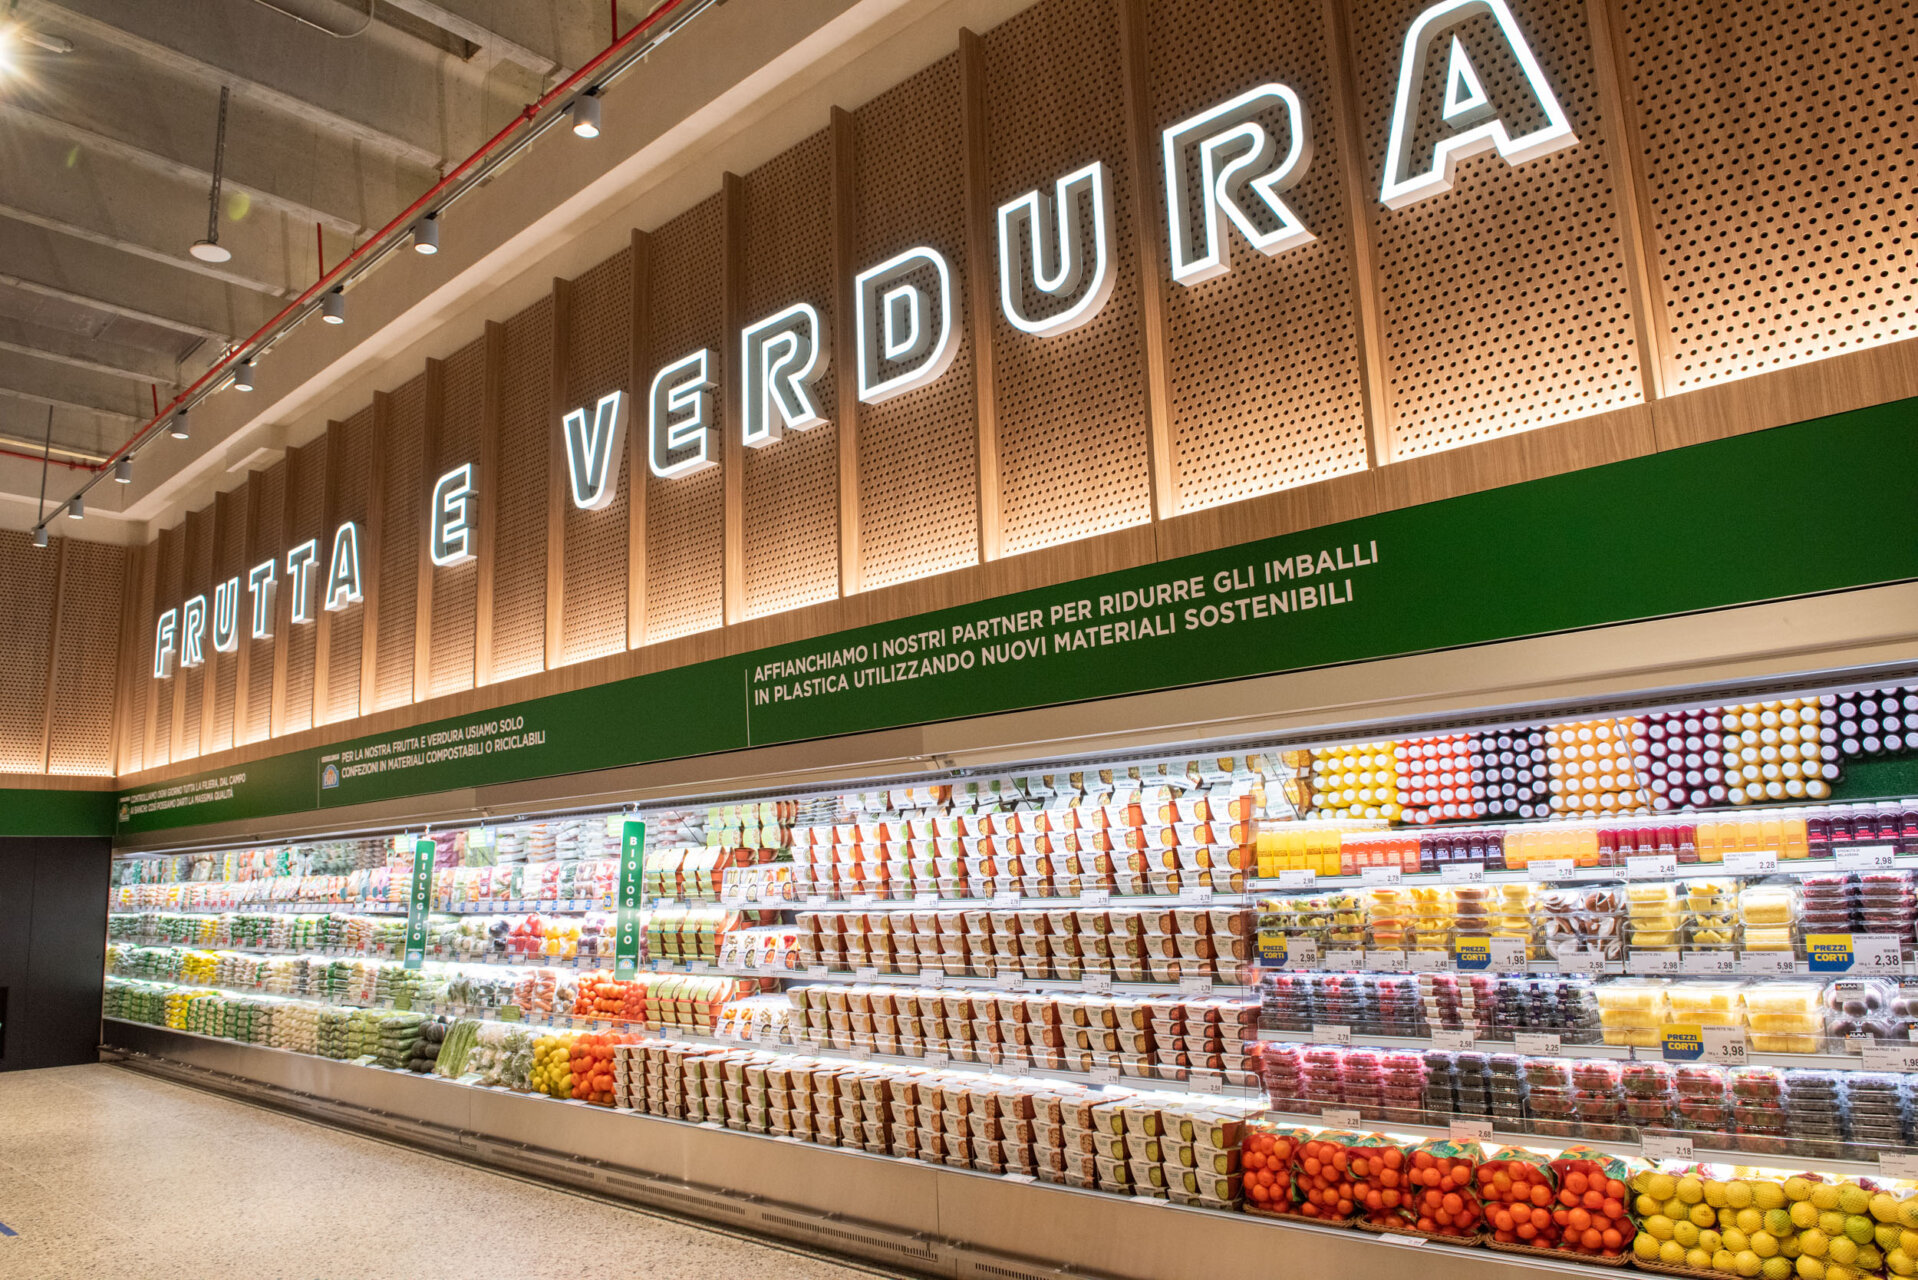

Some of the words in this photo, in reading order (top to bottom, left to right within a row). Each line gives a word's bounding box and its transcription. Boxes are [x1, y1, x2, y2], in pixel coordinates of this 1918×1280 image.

[154, 521, 363, 679] FRUTTA
[430, 462, 477, 567] E
[562, 0, 1579, 510] VERDURA
[754, 645, 868, 683] AFFIANCHIAMO
[872, 641, 879, 660] I
[882, 629, 947, 658] NOSTRI
[952, 608, 1043, 645] PARTNER
[1050, 599, 1093, 625] PER
[1099, 576, 1206, 617] RIDURRE
[1213, 565, 1255, 593] GLI
[1264, 540, 1378, 584] IMBALLI
[754, 687, 769, 706] IN
[774, 673, 849, 702] PLASTICA
[853, 649, 976, 688] UTILIZZANDO
[981, 635, 1046, 666] NUOVI
[1054, 612, 1176, 653] MATERIALI
[1184, 578, 1354, 630] SOSTENIBILI
[341, 750, 355, 763] PER
[354, 748, 364, 760] LA
[364, 743, 392, 758] NOSTRA
[392, 737, 420, 754] FRUTTA
[420, 737, 426, 748] E
[427, 728, 464, 747] VERDURA
[465, 722, 498, 739] USIAMO
[500, 716, 524, 732] SOLO
[341, 762, 379, 778] CONFEZIONI
[380, 760, 387, 771] IN
[388, 752, 425, 769] MATERIALI
[426, 742, 484, 763] COMPOSTABILI
[485, 740, 492, 753] O
[494, 730, 546, 753] RICICLABILI
[220, 776, 230, 787] DAL
[229, 773, 246, 784] CAMPO
[413, 853, 428, 940] BIOLOGICO
[623, 836, 638, 945] BIOLOGICO
[1263, 952, 1285, 960] CORTI
[1461, 953, 1487, 961] CORTI
[1814, 953, 1848, 962] CORTI
[1874, 955, 1899, 967] 2,38
[1667, 1042, 1698, 1051] CORTI
[1722, 1045, 1744, 1057] 3,98
